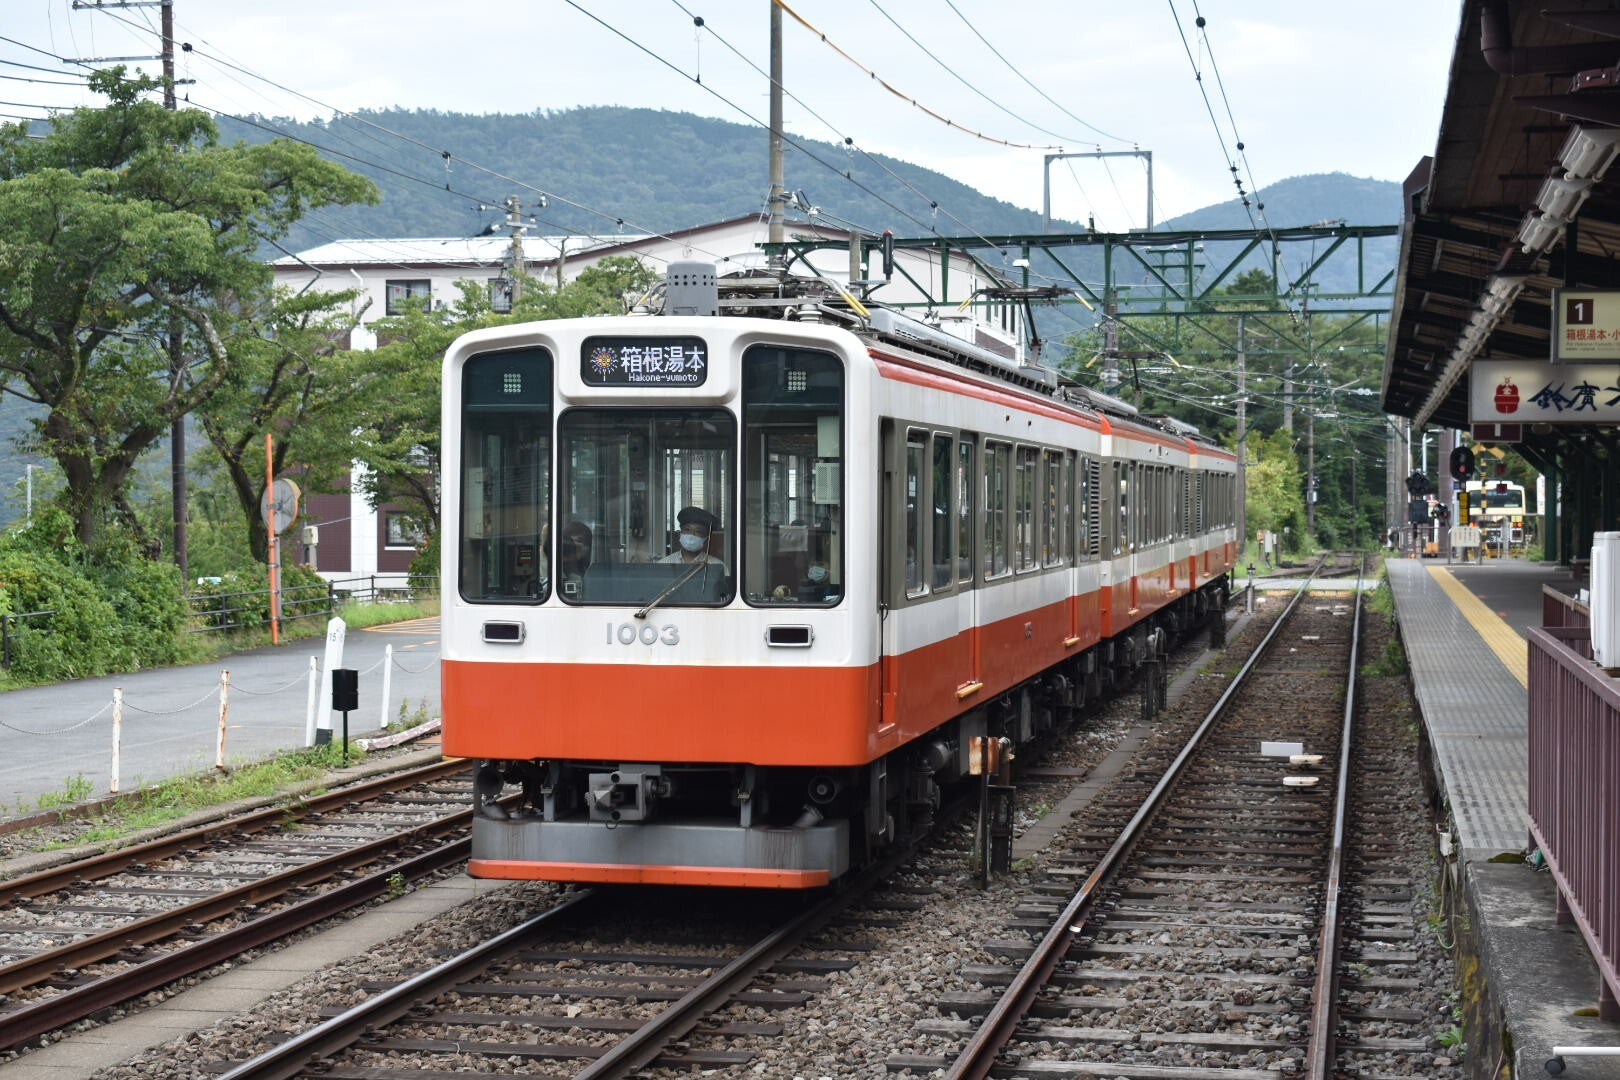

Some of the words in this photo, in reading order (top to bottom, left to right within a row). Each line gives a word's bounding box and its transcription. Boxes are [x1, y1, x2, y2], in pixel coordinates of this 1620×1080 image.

[1574, 302, 1584, 321] 1
[620, 345, 705, 373] 箱根湯本
[628, 373, 698, 382] Hakone-yumoto
[606, 622, 680, 646] 1003
